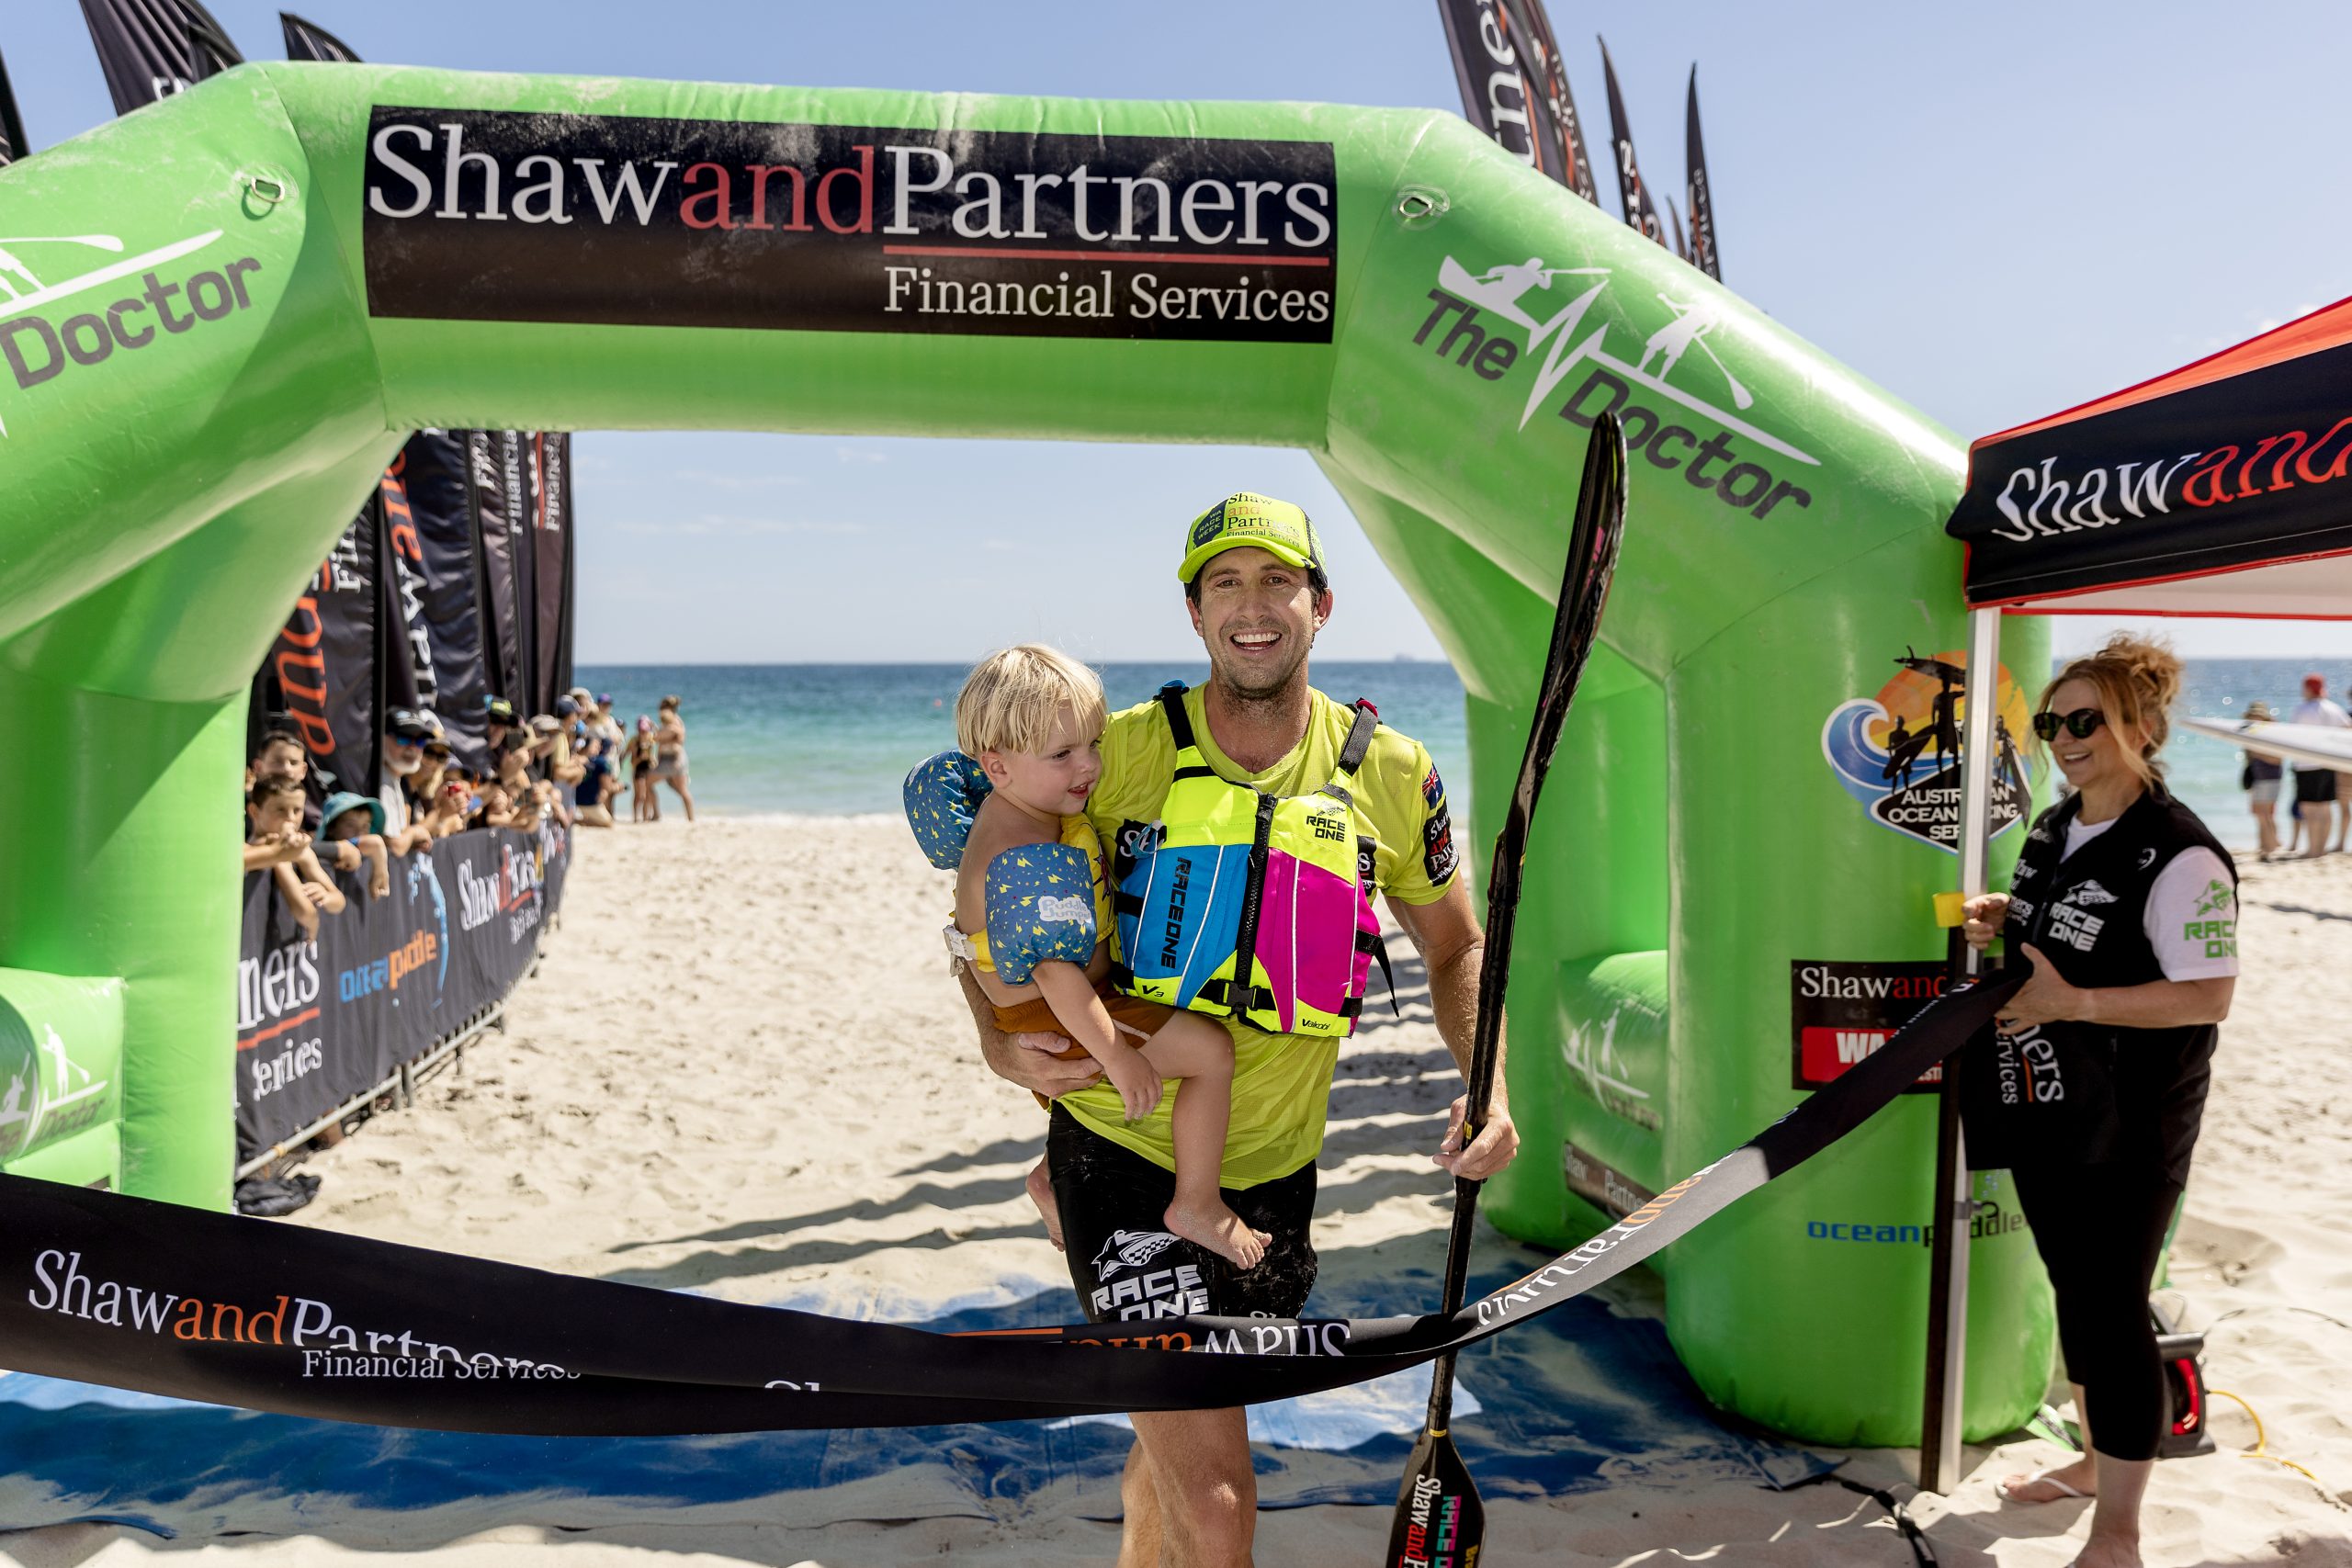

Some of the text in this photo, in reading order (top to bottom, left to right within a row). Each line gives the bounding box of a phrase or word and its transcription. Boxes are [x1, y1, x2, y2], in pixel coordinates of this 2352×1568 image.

[883, 265, 1329, 322] Financial Services
[0, 257, 262, 389] Doctor
[1412, 288, 1518, 381] The
[1559, 368, 1812, 520] Doctor
[1199, 516, 1221, 533] RACE
[1227, 505, 1261, 516] and
[1198, 523, 1221, 540] WEEK
[1306, 816, 1345, 832] RACE
[1315, 828, 1345, 842] ONE
[1043, 899, 1087, 911] Puddle
[2049, 902, 2105, 935] RACE
[2048, 920, 2097, 952] ONE
[2184, 920, 2235, 941] RAC
[2206, 940, 2238, 958] ON
[1091, 1264, 1204, 1316] RACE
[1121, 1288, 1210, 1322] ONE
[302, 1349, 445, 1379] Financial
[1436, 1495, 1462, 1552] RACE
